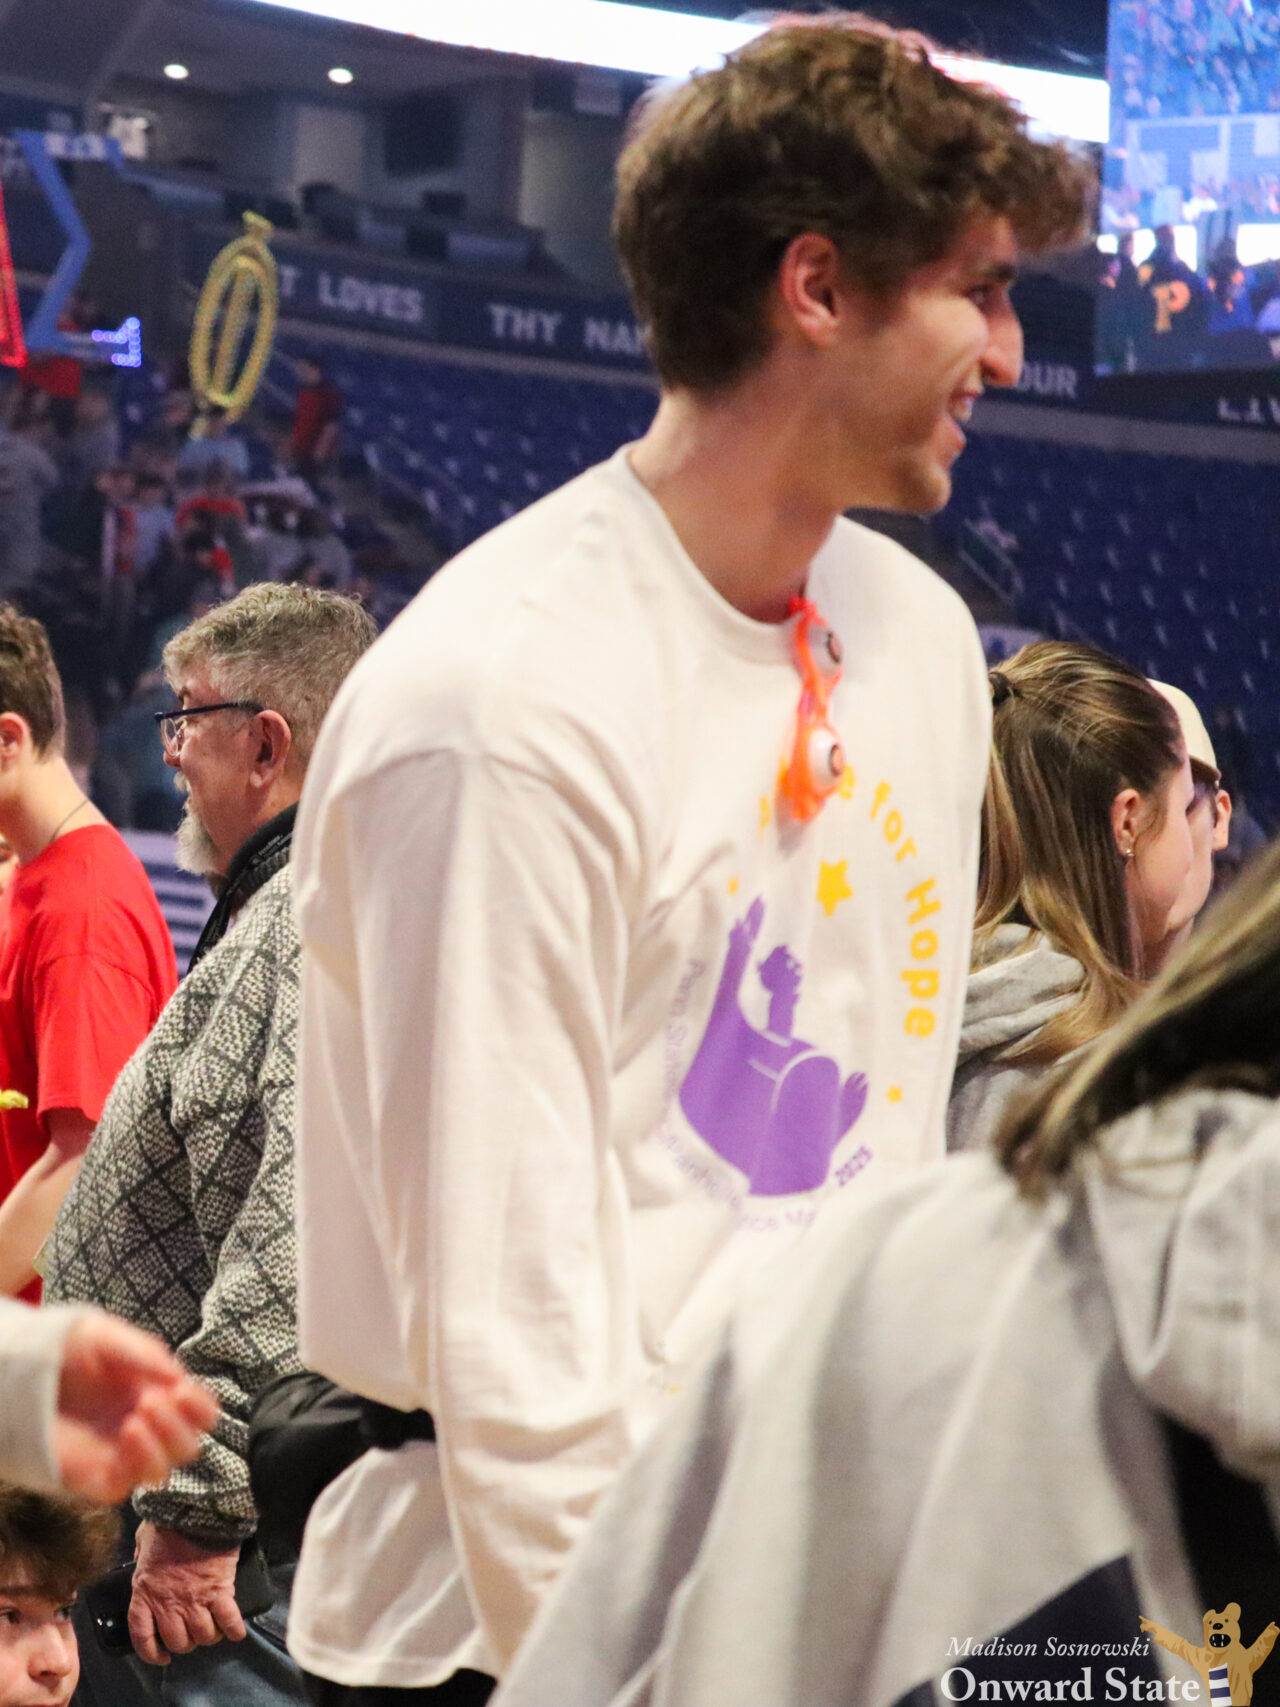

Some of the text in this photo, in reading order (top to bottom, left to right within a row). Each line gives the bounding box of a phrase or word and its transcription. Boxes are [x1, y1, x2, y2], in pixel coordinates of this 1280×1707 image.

[320, 272, 424, 322] LOVES
[489, 303, 562, 346] THY
[869, 780, 942, 1039] for Hope
